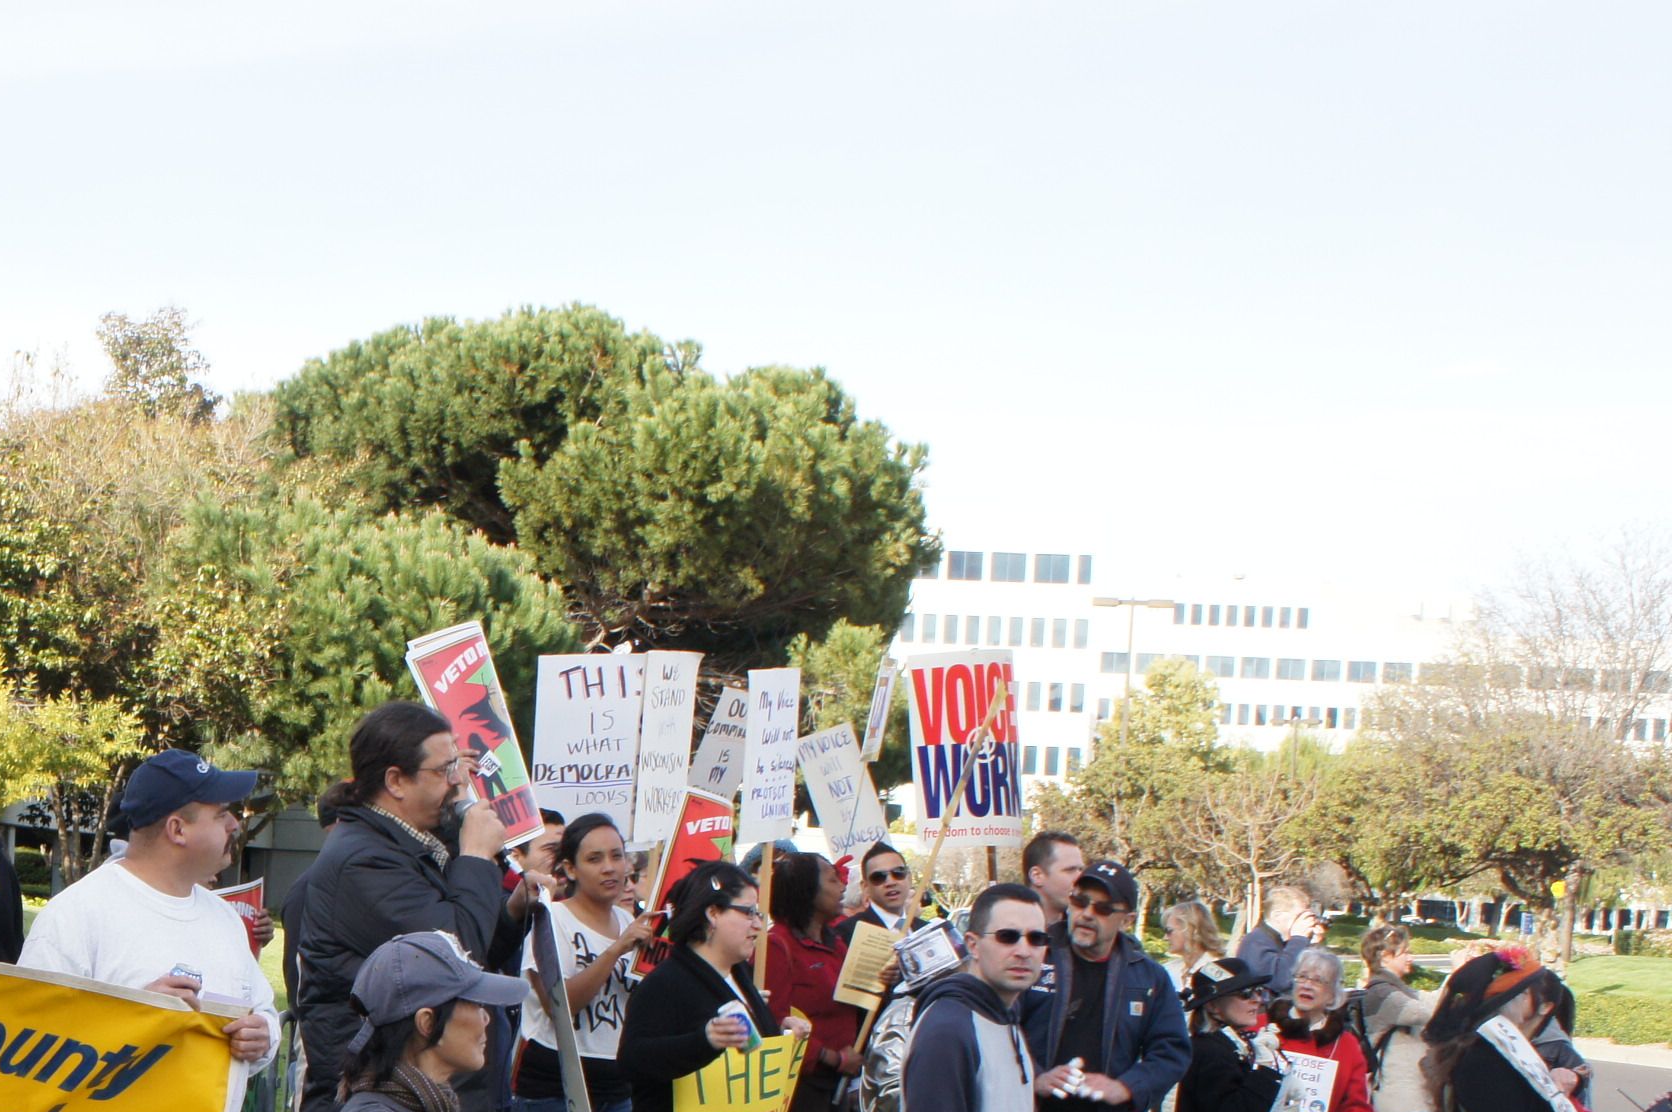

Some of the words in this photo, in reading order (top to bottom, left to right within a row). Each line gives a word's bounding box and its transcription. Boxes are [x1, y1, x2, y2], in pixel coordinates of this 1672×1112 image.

[663, 664, 680, 682] WE
[652, 686, 685, 709] STAND
[911, 662, 1018, 746] VOICE
[590, 709, 615, 735] IS
[567, 737, 627, 755] WHAT
[718, 749, 730, 763] IS
[799, 740, 818, 762] MY
[817, 729, 852, 752] VOICE
[534, 763, 633, 783] DEMOCRA
[641, 752, 685, 774] WISCONSIN
[708, 766, 727, 783] MY
[916, 740, 1022, 820] WORK
[751, 785, 788, 800] PROTECT
[828, 776, 854, 798] NOT
[831, 825, 886, 853] SILENCED
[923, 826, 968, 842] fredom
[971, 826, 981, 836] to
